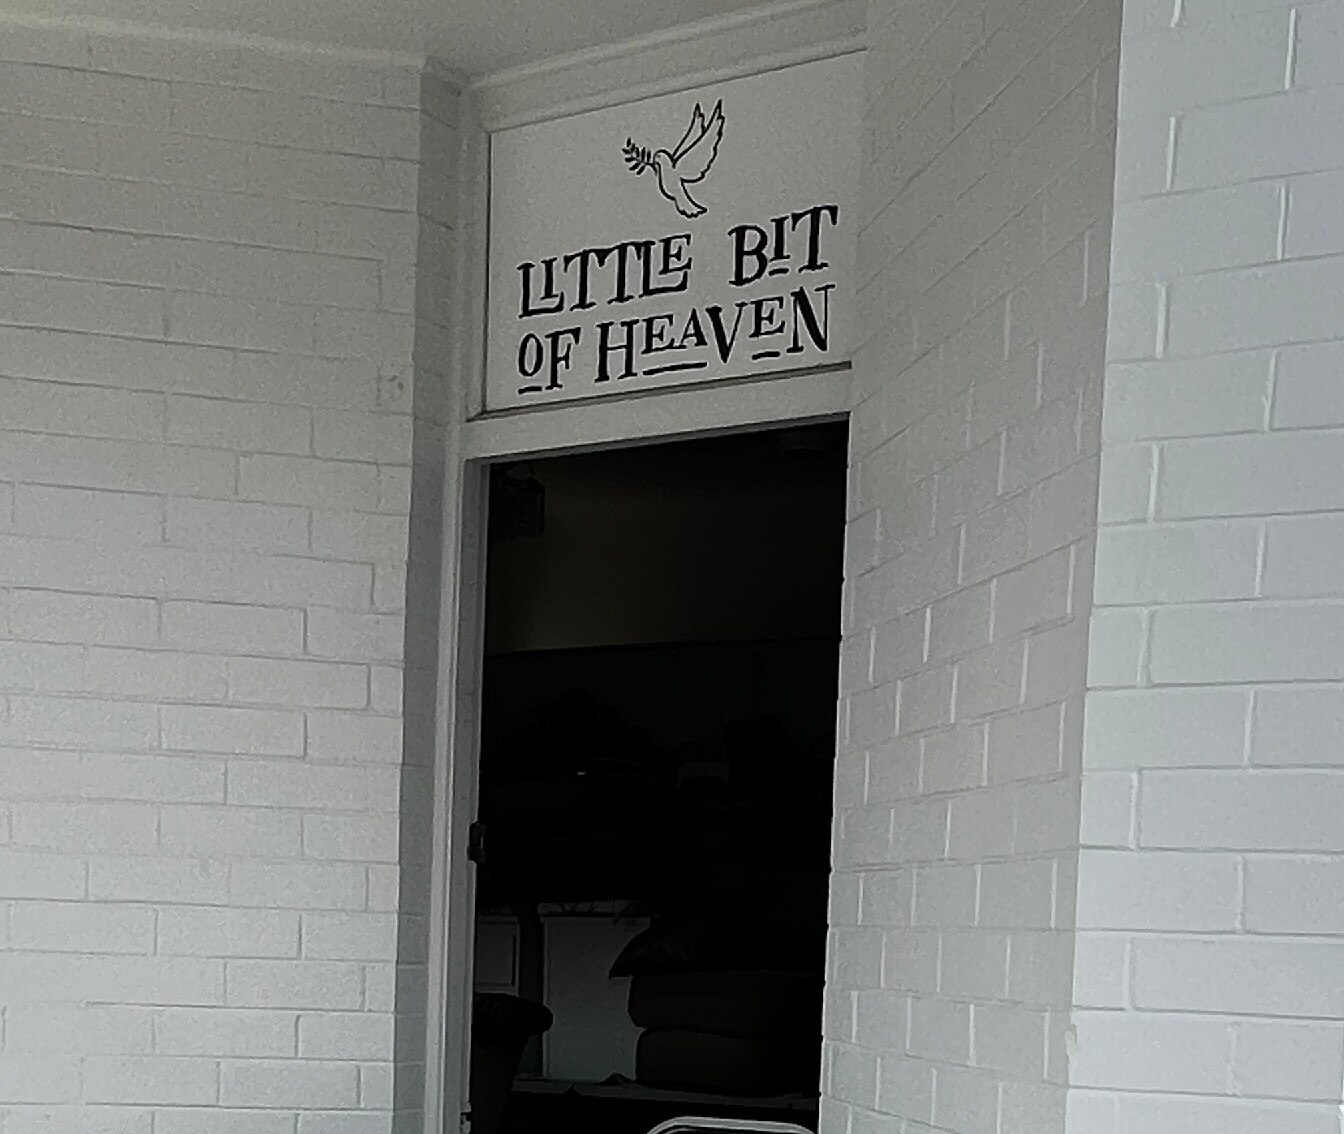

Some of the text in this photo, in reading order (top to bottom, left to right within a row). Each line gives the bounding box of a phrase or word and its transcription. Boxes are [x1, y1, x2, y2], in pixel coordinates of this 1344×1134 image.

[517, 204, 839, 319] LITTLE BIT
[517, 283, 837, 394] OF HEAVEN
